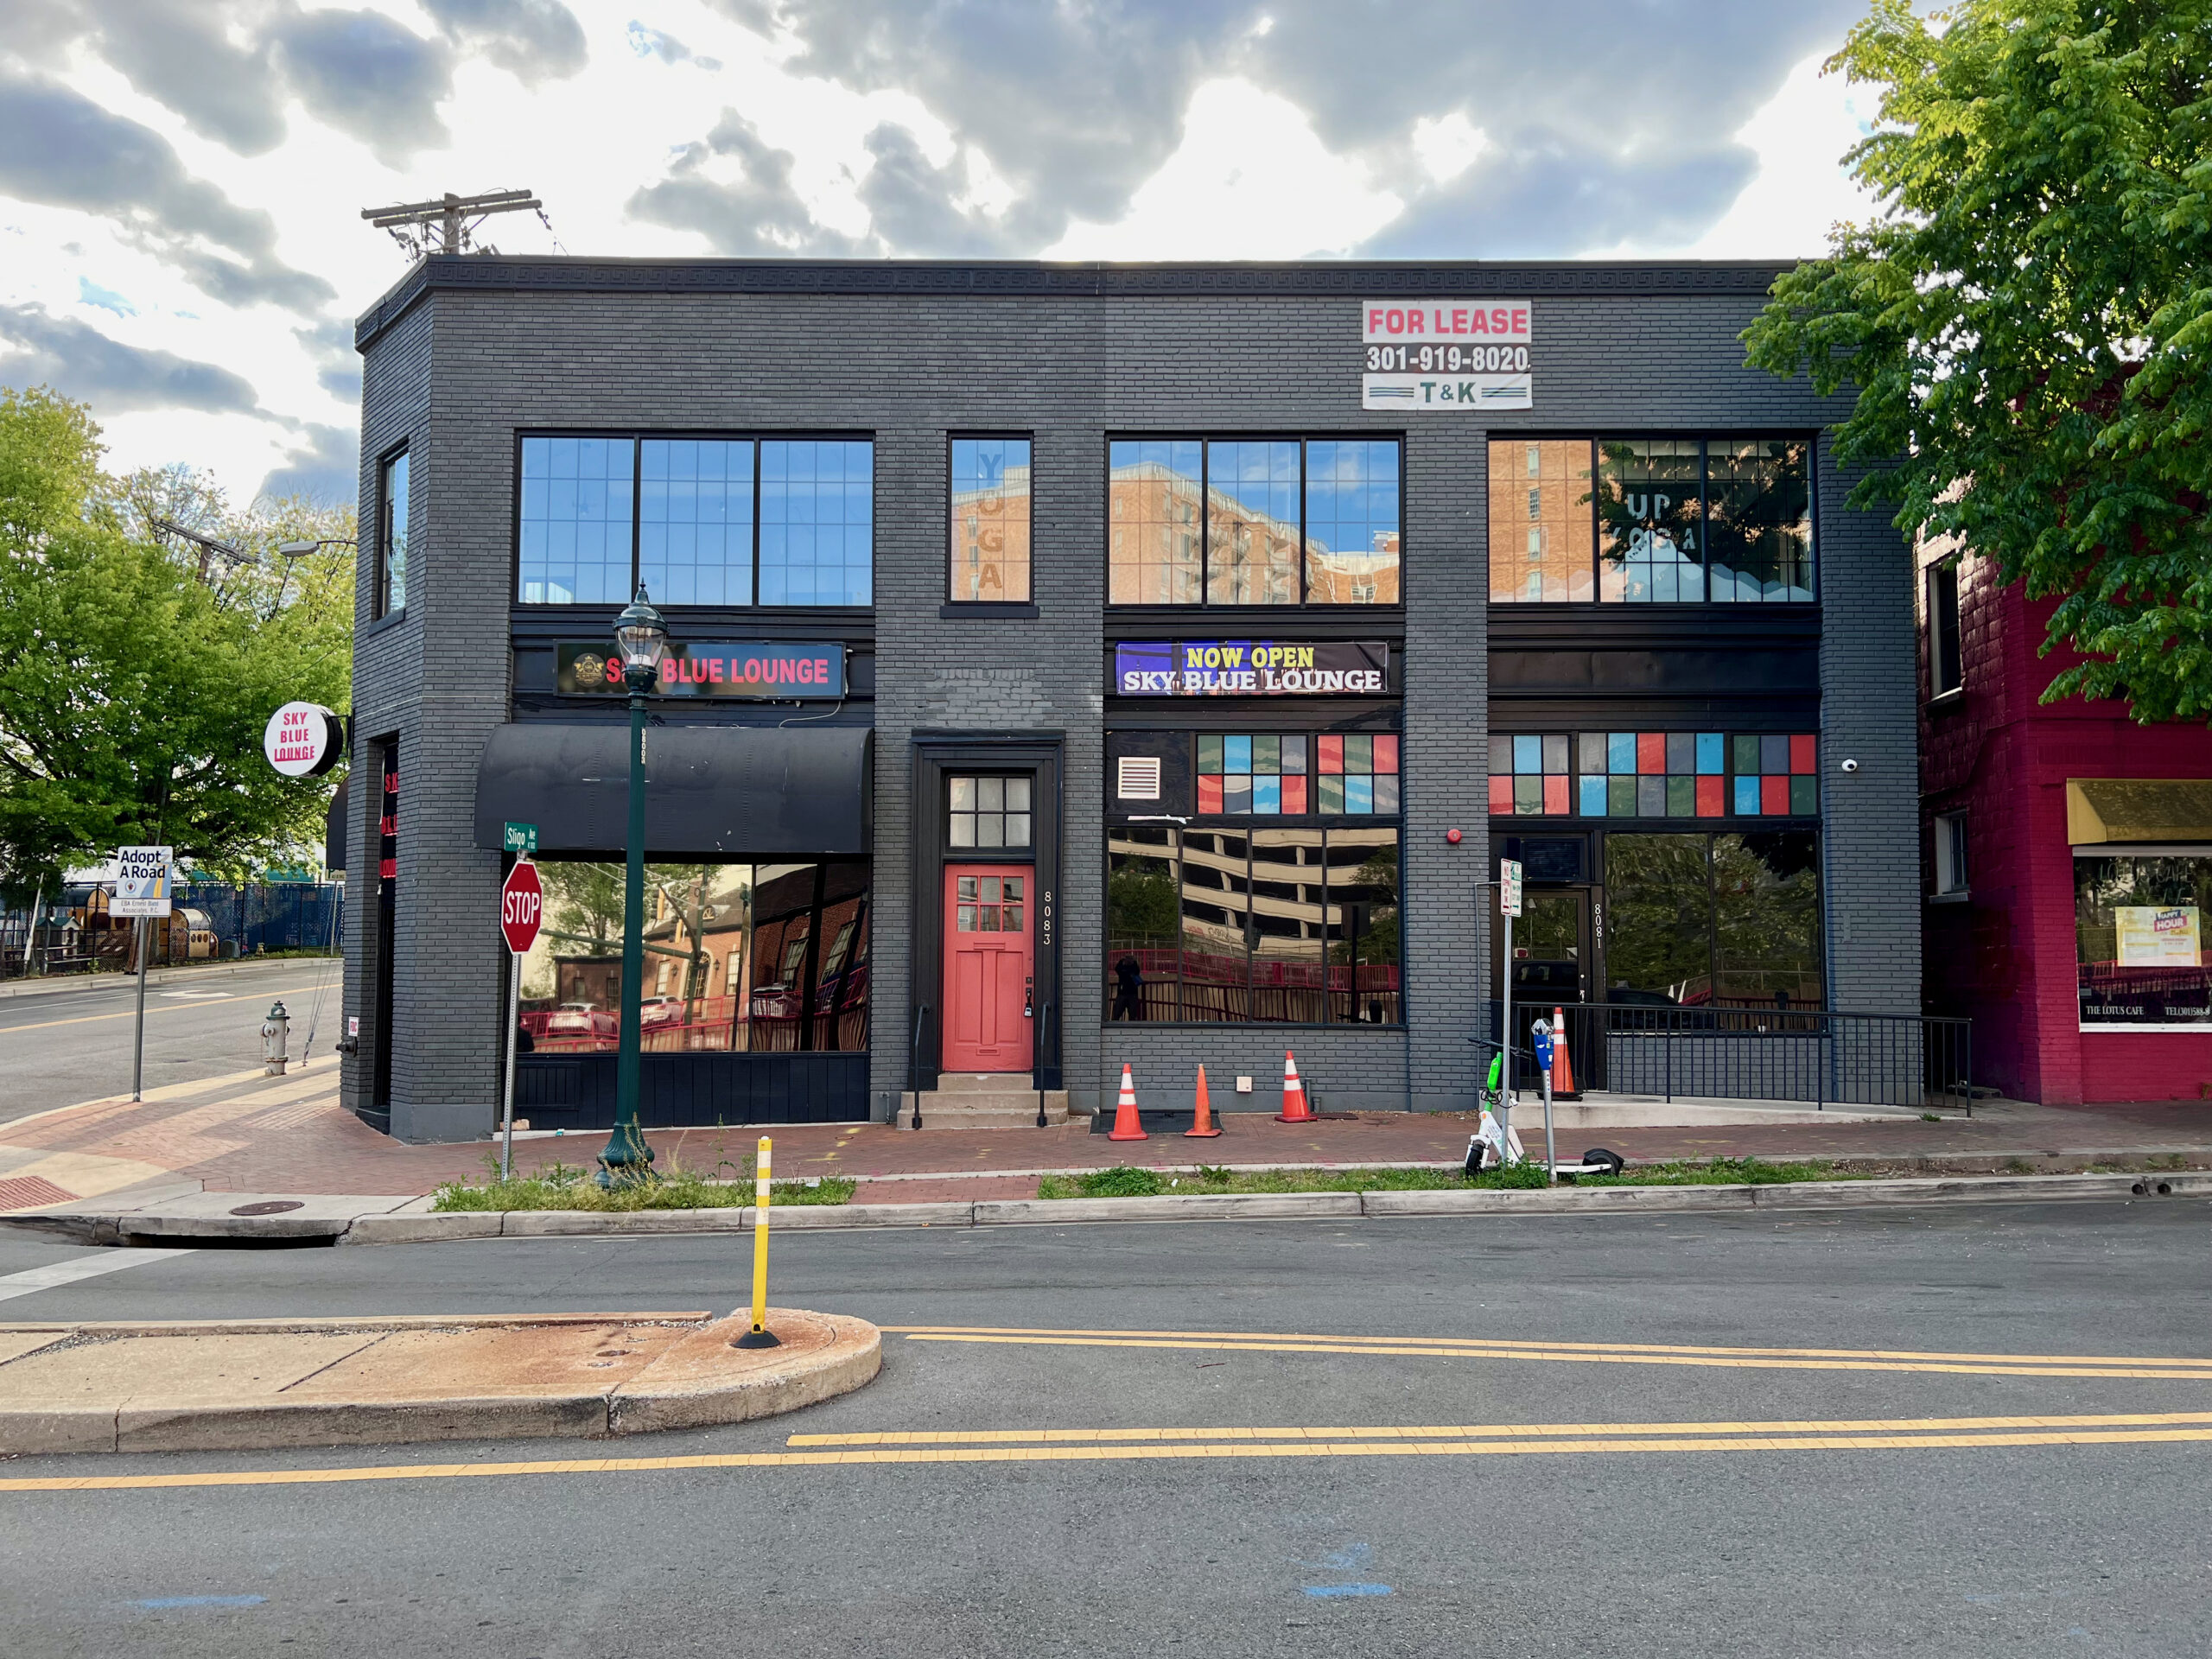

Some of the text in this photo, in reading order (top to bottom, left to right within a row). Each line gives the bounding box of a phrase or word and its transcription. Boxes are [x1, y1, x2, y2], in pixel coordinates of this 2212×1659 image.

[1369, 308, 1528, 334] FOR LEASE
[1367, 346, 1529, 372] 301-919-8020
[1420, 382, 1477, 404] T & K
[1627, 493, 1670, 519] UP
[978, 454, 1005, 589] YOGA
[1186, 647, 1314, 668] NOW OPEN
[662, 658, 723, 683] BLUE
[731, 658, 829, 683] LOUNGE
[1123, 670, 1382, 690] SKY BLUE LOUNGE
[283, 712, 308, 726] SKY
[280, 728, 309, 743] BLUE
[274, 746, 315, 762] LOUNGE
[507, 827, 525, 849] Sligo
[121, 850, 162, 866] Adopt
[120, 865, 166, 878] A Road
[505, 890, 540, 925] STOP
[2157, 918, 2183, 931] HOUR
[2086, 1006, 2145, 1015] THE LOTUS CAFE
